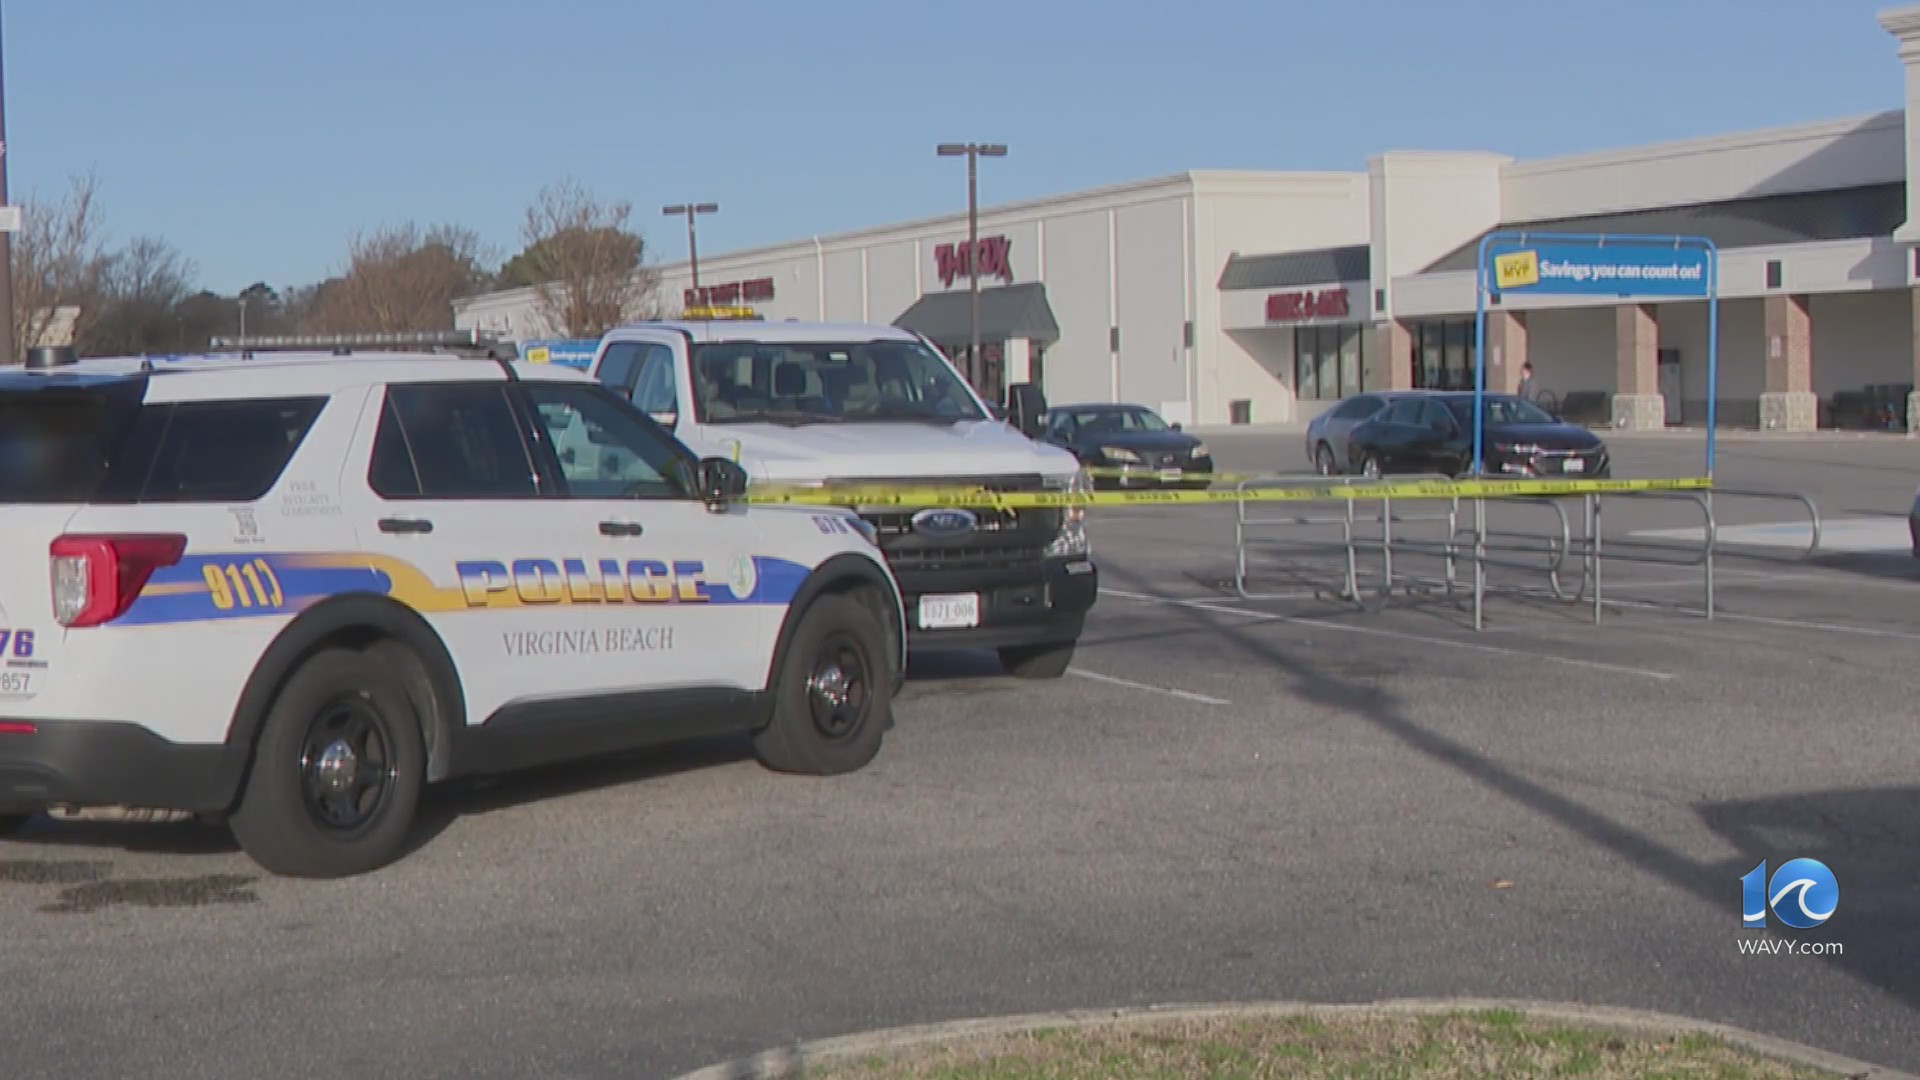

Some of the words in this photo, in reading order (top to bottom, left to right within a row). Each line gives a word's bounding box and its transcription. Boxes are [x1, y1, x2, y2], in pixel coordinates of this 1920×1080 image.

[1539, 259, 1591, 280] Savings
[1592, 263, 1616, 281] you
[1617, 265, 1641, 278] can
[1642, 263, 1679, 279] count
[1680, 263, 1701, 279] on!
[456, 558, 711, 607] POLICE
[502, 628, 600, 656] VIRGINIA
[604, 626, 674, 651] BEACH
[0, 672, 30, 692] 857
